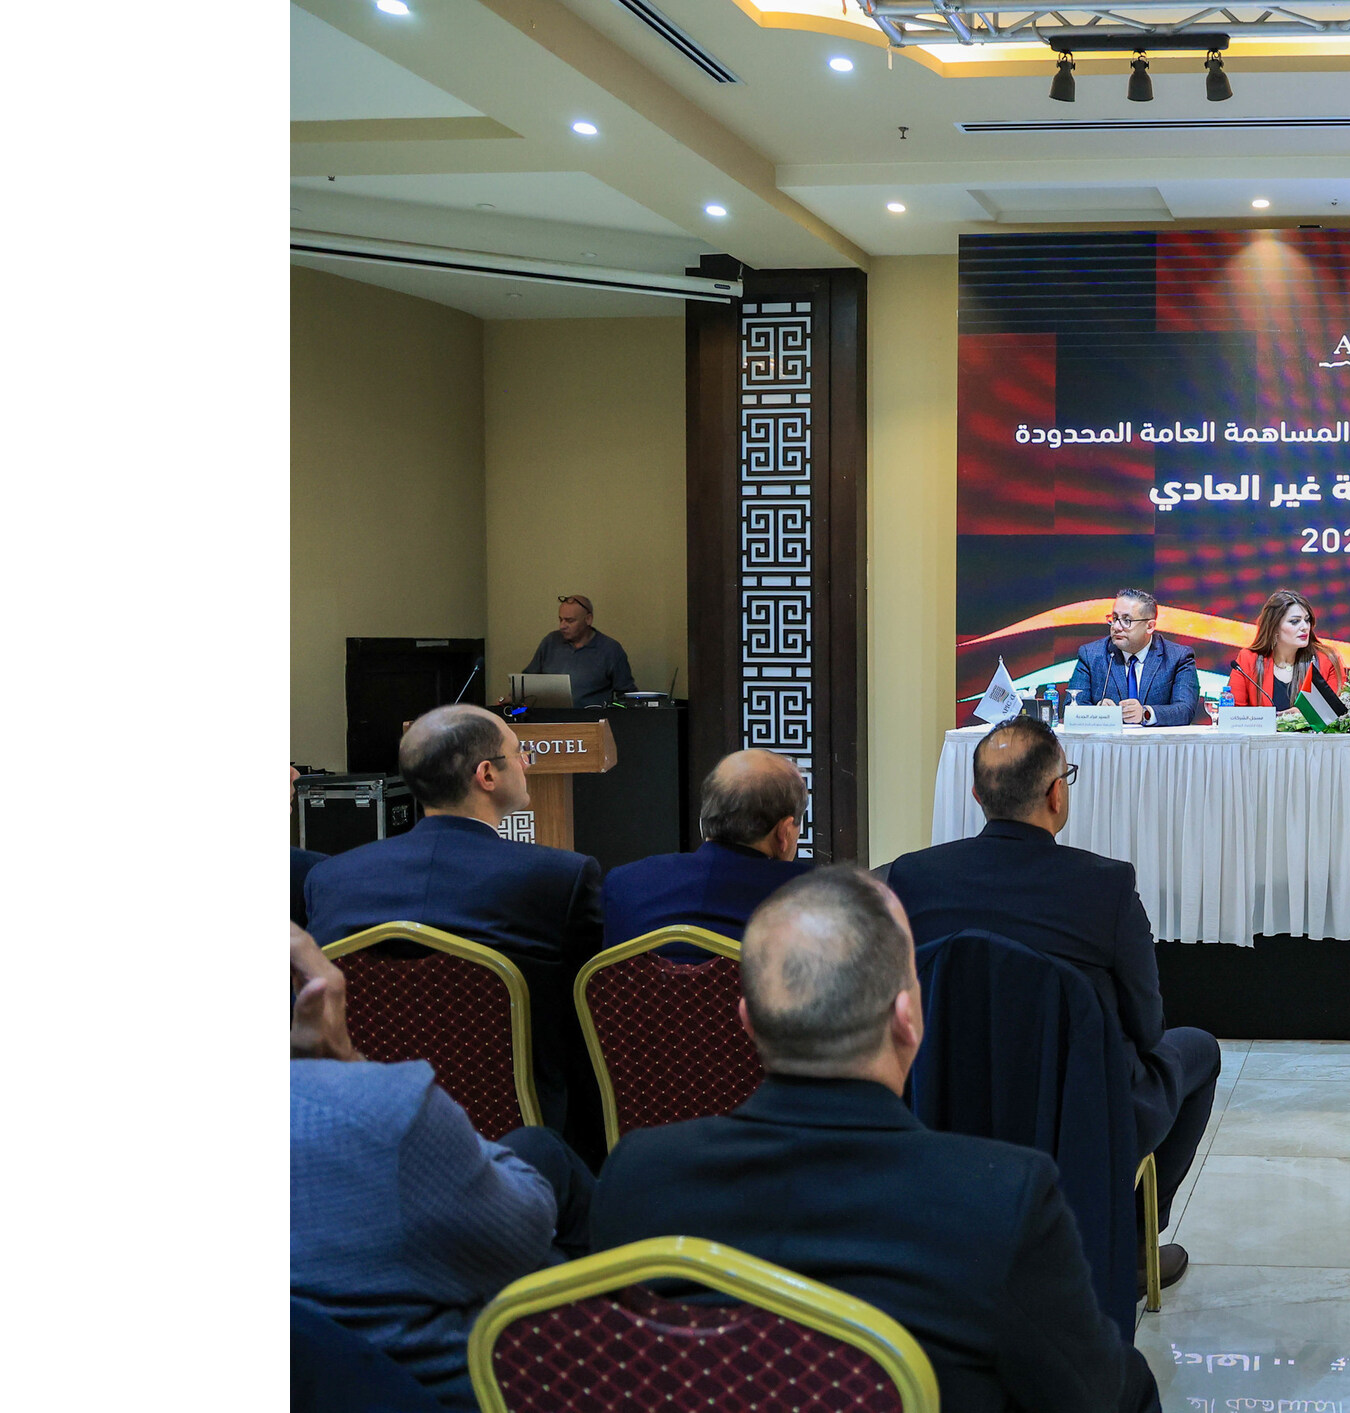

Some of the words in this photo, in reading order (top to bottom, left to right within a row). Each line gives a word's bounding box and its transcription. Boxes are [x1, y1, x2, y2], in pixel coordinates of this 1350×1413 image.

[1015, 421, 1132, 448] المحدودة
[1139, 421, 1216, 443] العامة
[1224, 421, 1350, 443] المساهمة
[1149, 475, 1260, 511] العادي
[1269, 475, 1322, 508] غير
[1002, 700, 1012, 716] APIC
